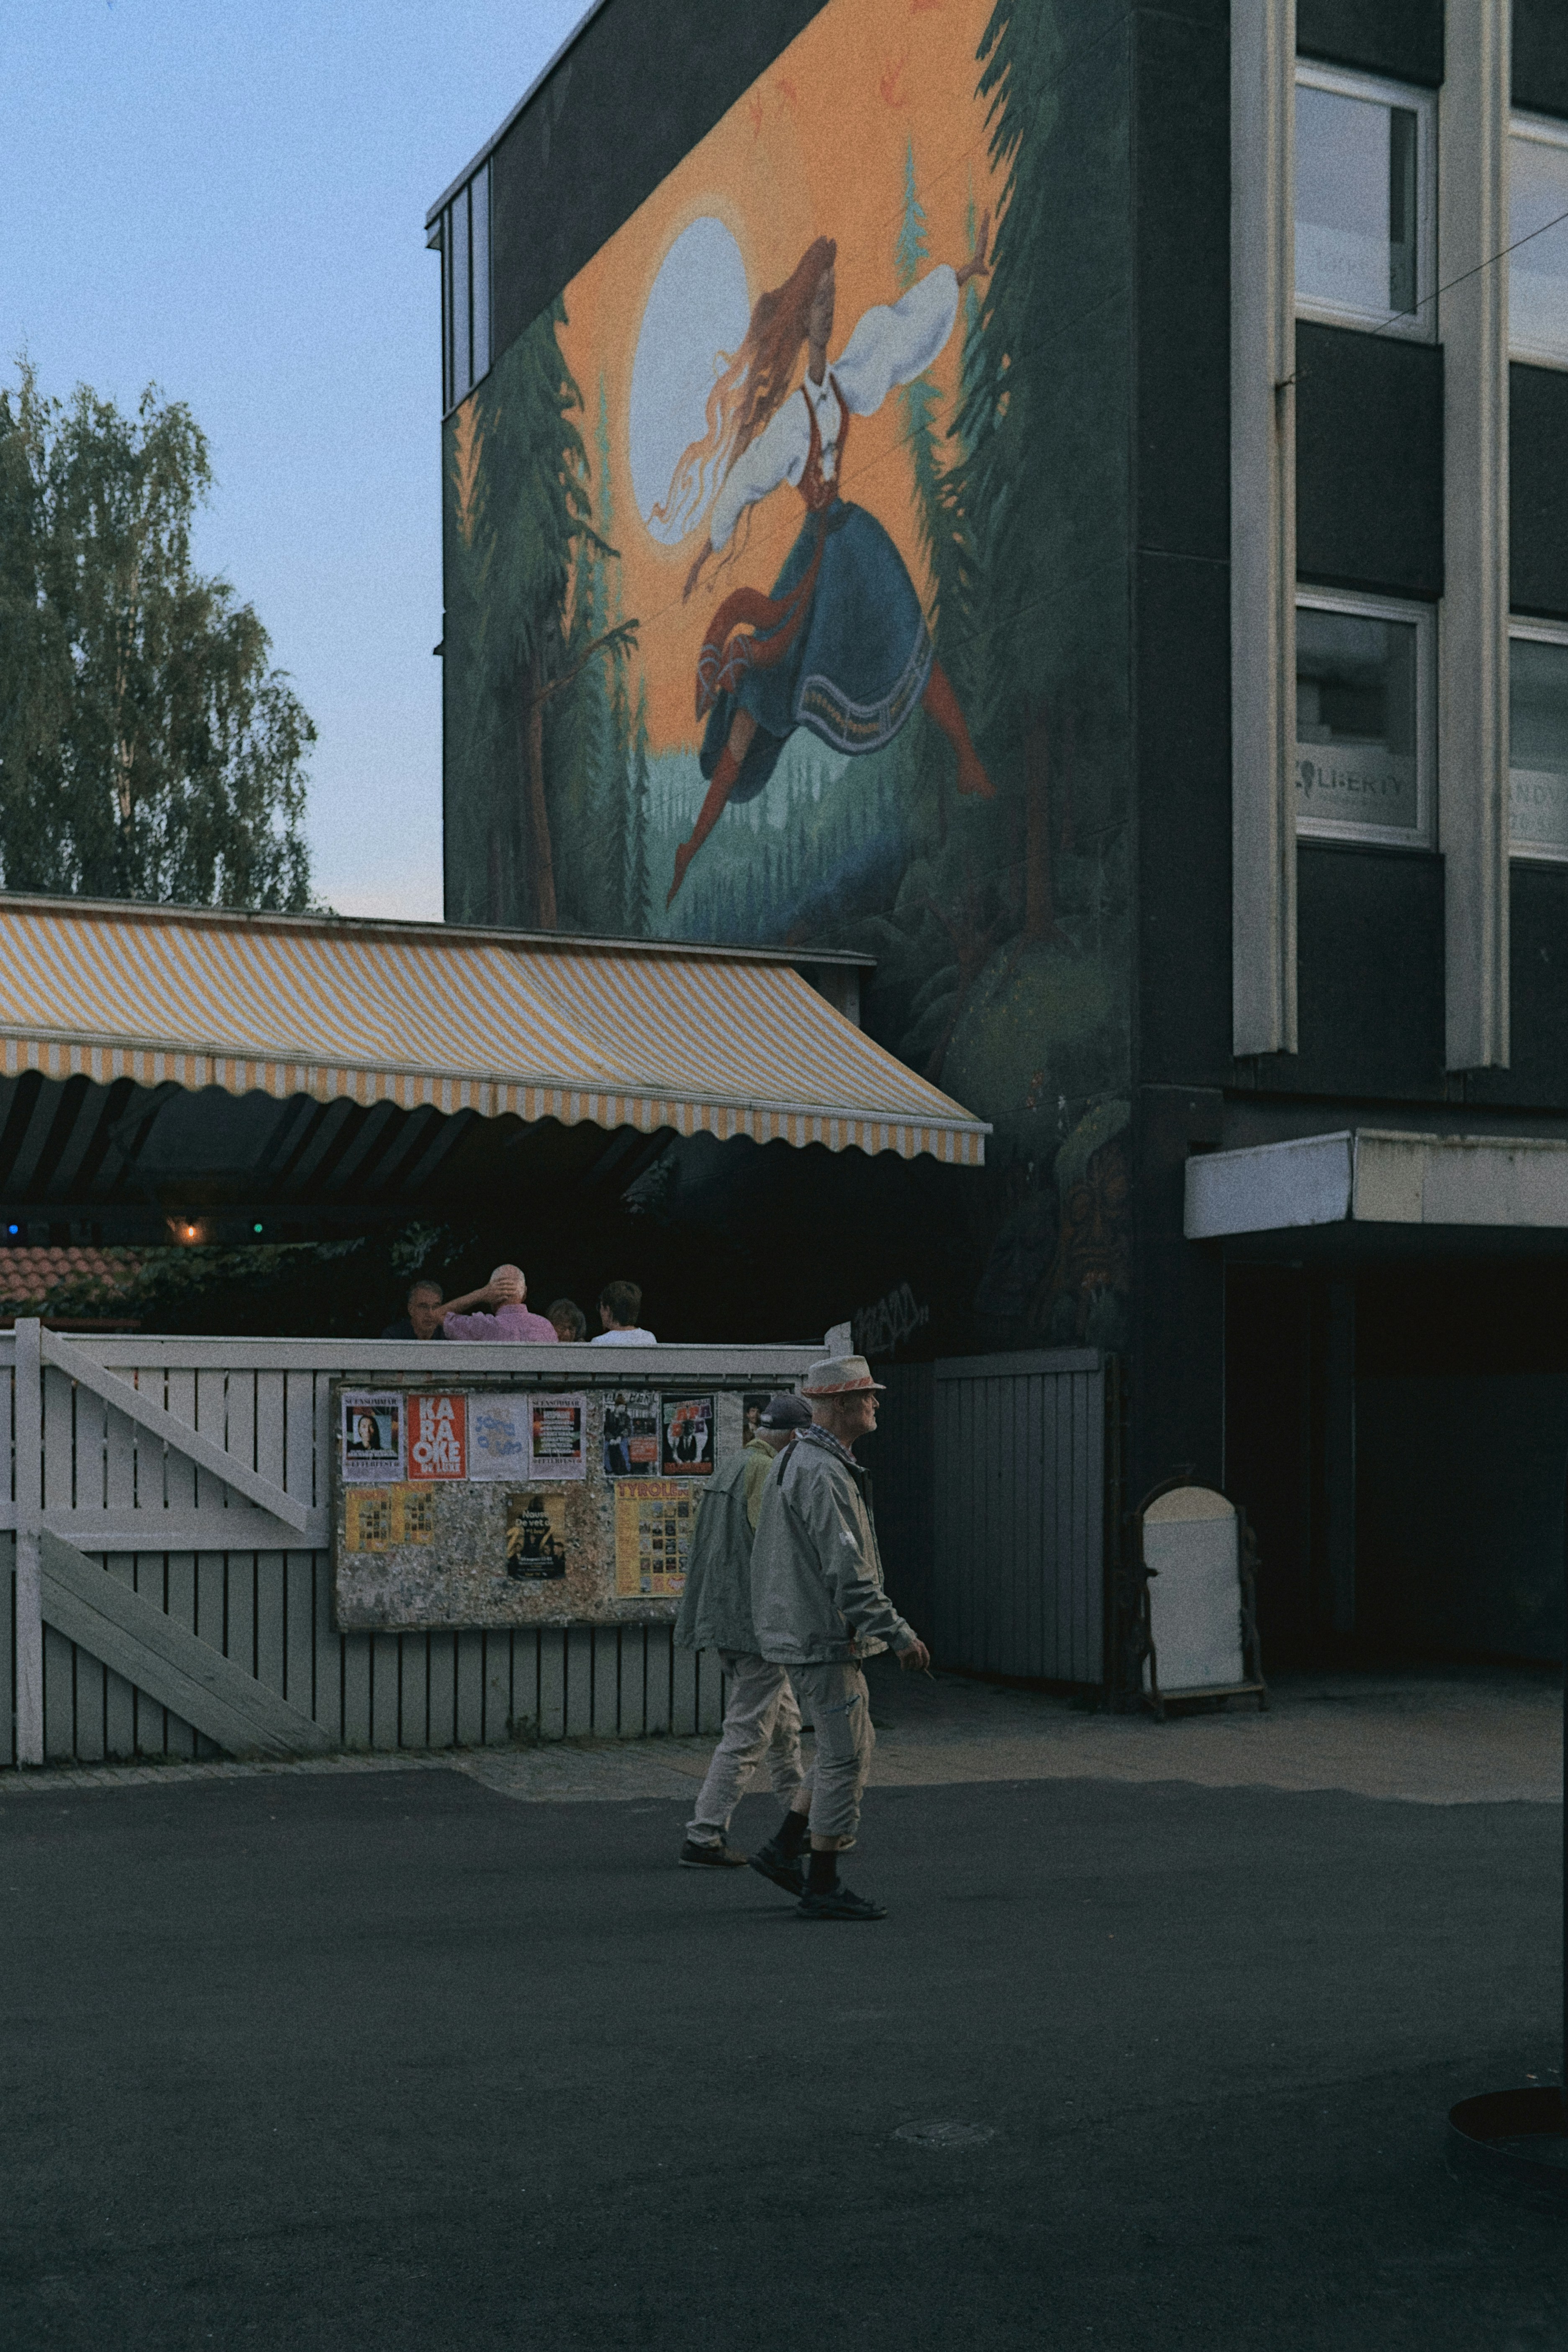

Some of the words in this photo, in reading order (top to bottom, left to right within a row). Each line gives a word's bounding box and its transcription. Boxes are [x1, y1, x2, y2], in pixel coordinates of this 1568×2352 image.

[419, 1397, 455, 1420] KA
[420, 1420, 455, 1442] RA
[412, 1441, 461, 1464] OKE
[515, 1518, 528, 1526] De
